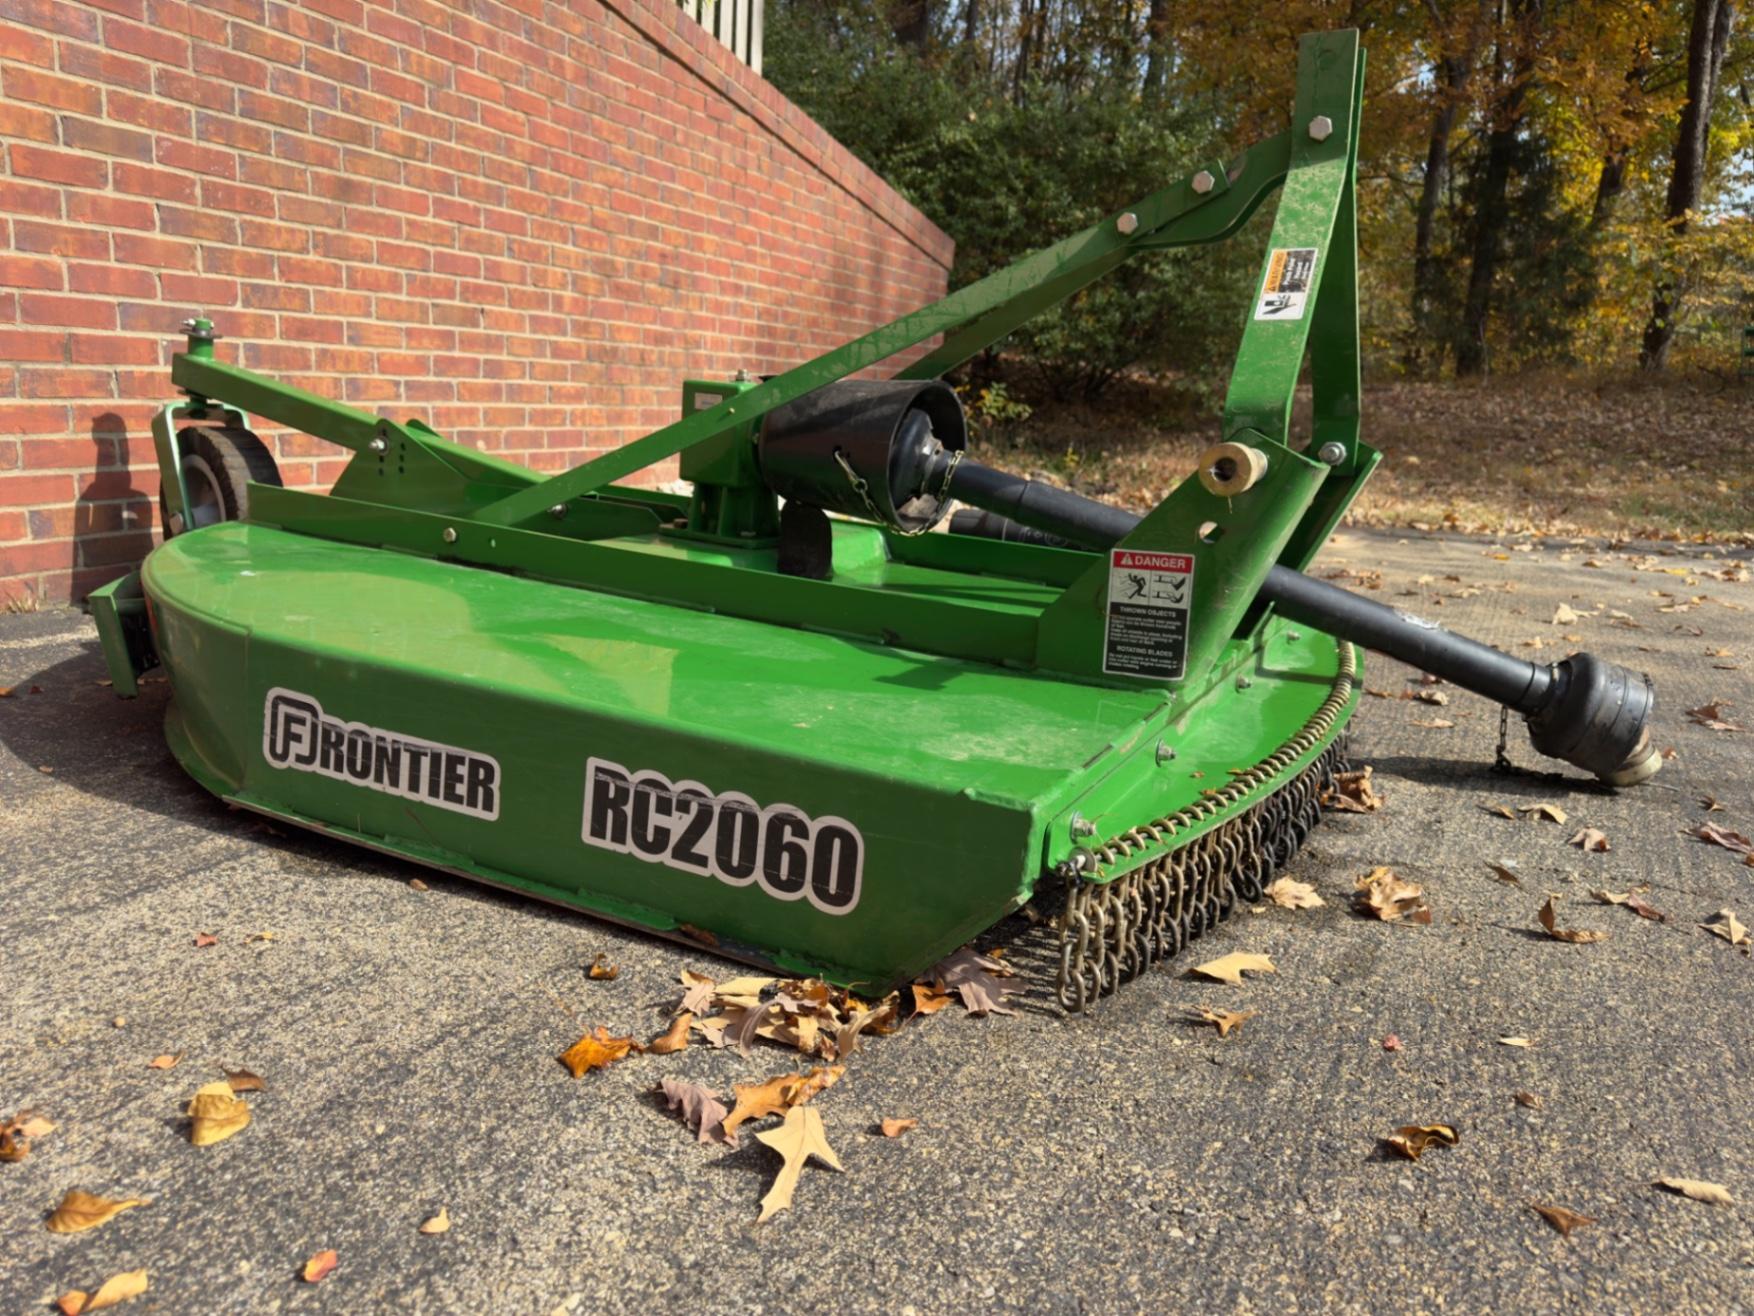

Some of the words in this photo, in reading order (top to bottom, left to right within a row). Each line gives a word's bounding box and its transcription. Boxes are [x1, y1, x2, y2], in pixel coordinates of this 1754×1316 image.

[1135, 555, 1186, 569] DANGER
[1148, 609, 1176, 618] OBJECTS
[1148, 649, 1173, 657] BLADES
[269, 695, 495, 813] FRONTIER
[590, 766, 859, 907] RC2060
